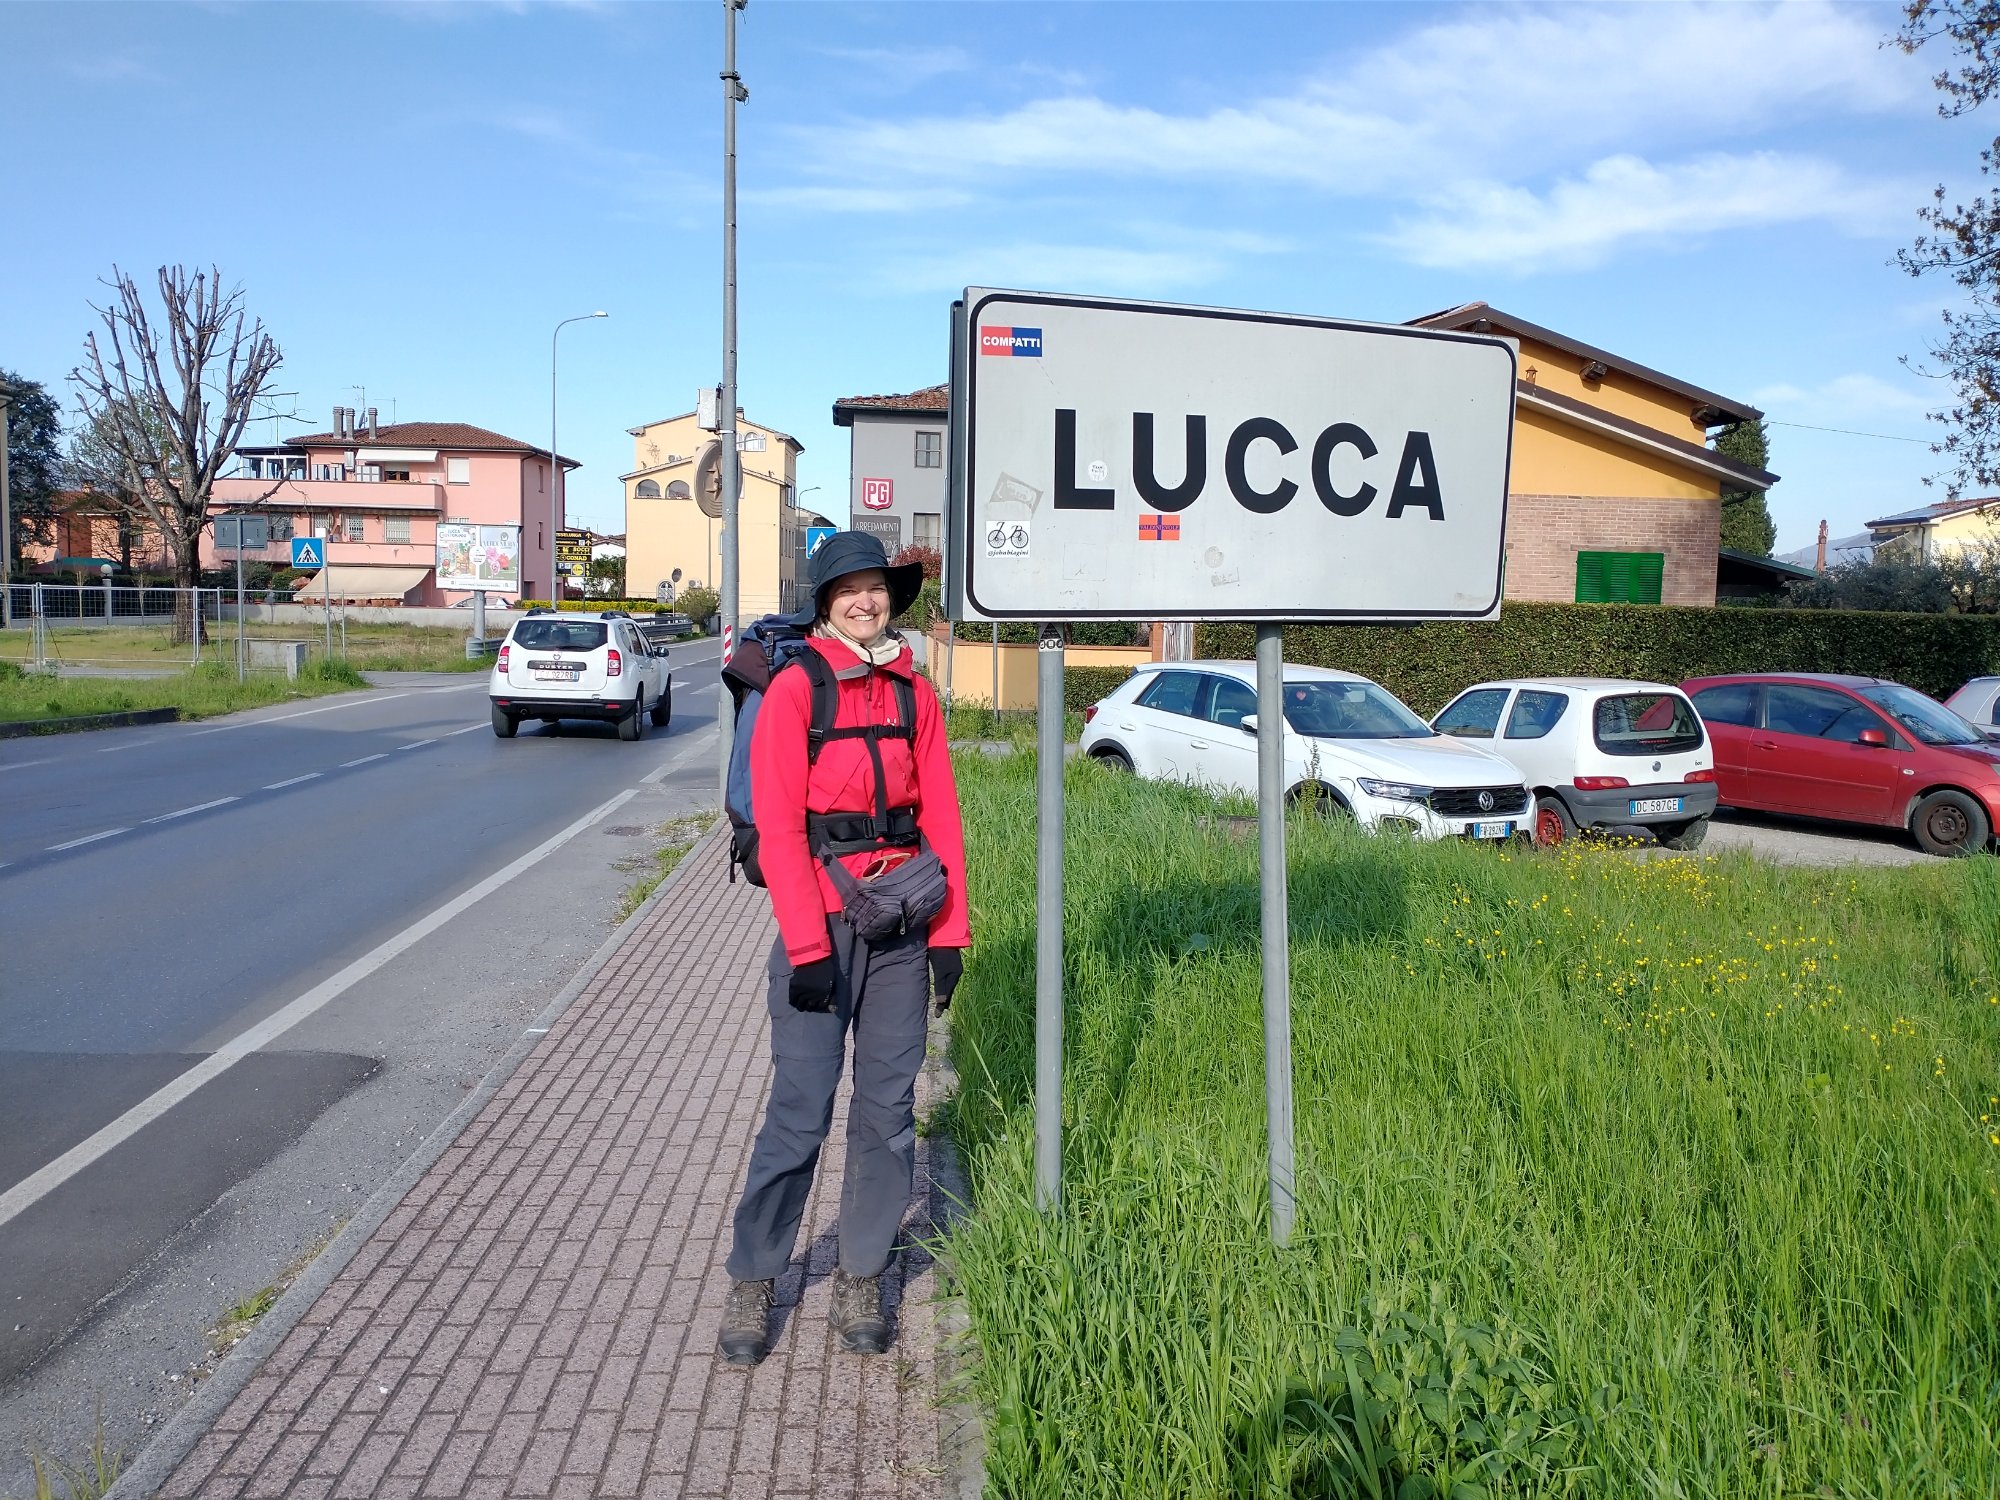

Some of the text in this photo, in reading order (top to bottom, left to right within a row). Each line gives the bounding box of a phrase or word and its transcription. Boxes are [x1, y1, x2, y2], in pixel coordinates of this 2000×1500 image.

[982, 335, 1041, 348] COMPATTI
[1053, 408, 1445, 521] LUCCA
[867, 482, 888, 503] PG
[855, 521, 899, 532] ARREDAMENTI
[1636, 801, 1648, 813] DC
[1650, 799, 1677, 812] 587GE
